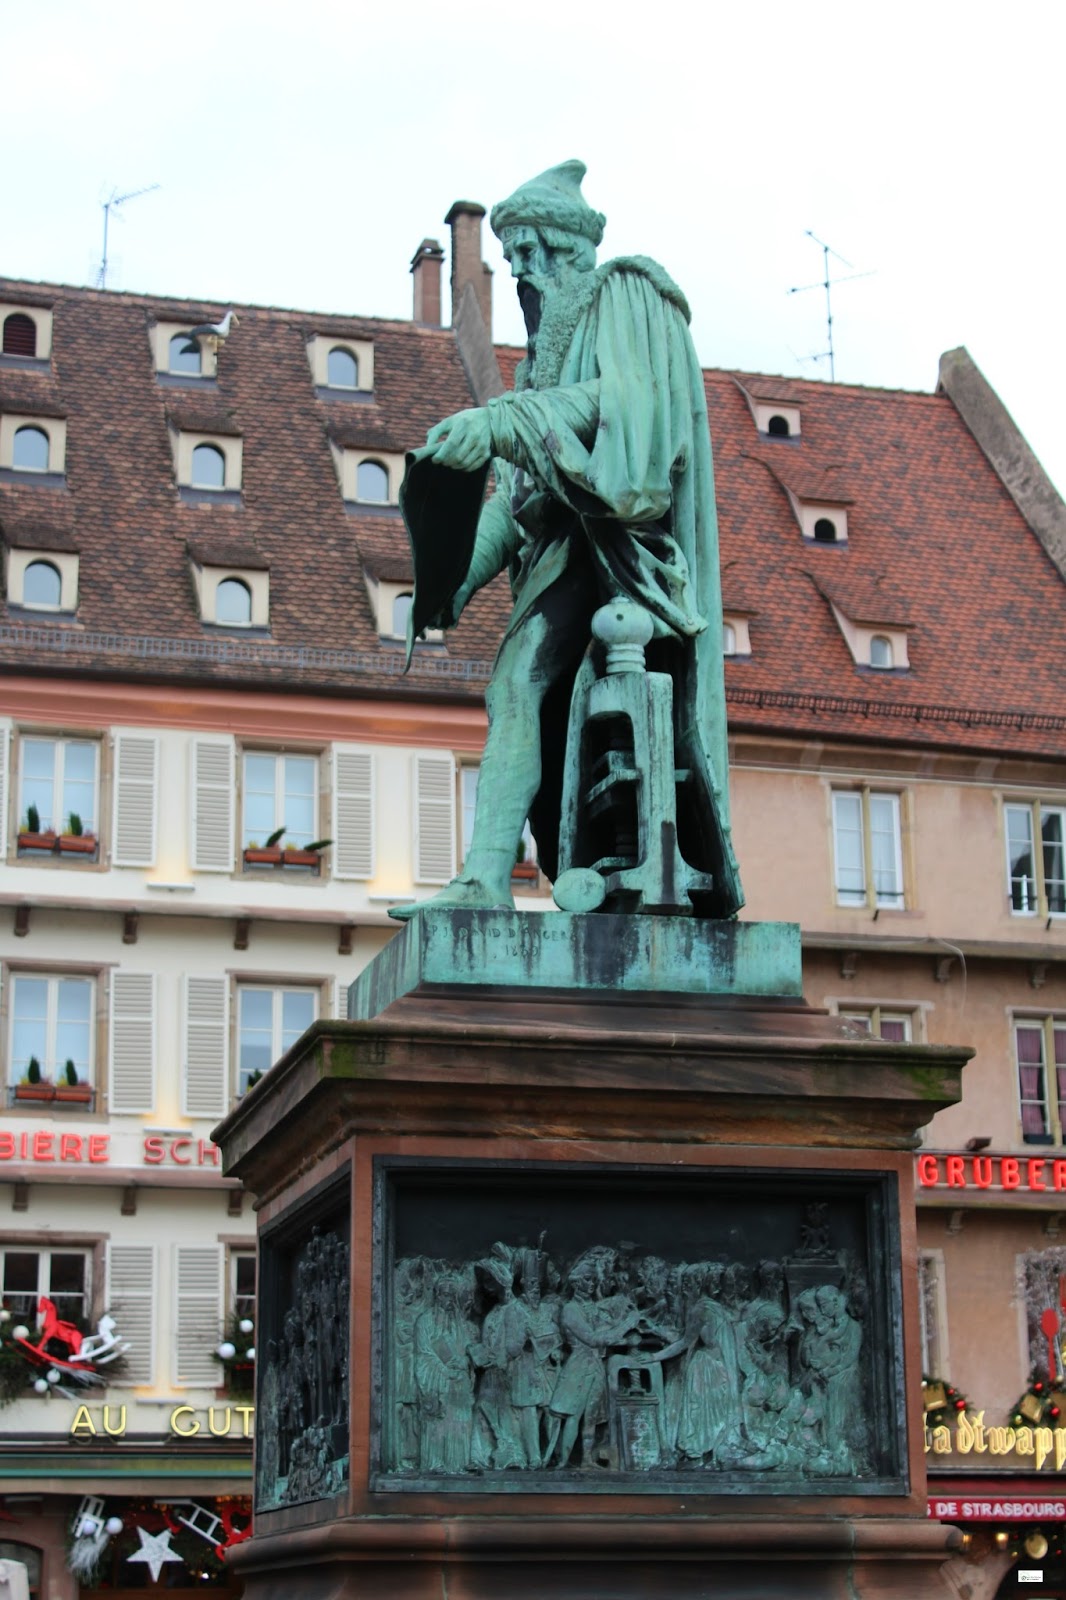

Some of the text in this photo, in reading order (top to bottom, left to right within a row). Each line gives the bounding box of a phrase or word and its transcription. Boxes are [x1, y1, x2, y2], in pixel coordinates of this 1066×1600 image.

[70, 1405, 127, 1435] AU
[936, 1502, 958, 1516] DE
[962, 1502, 1065, 1516] STRASBOURG
